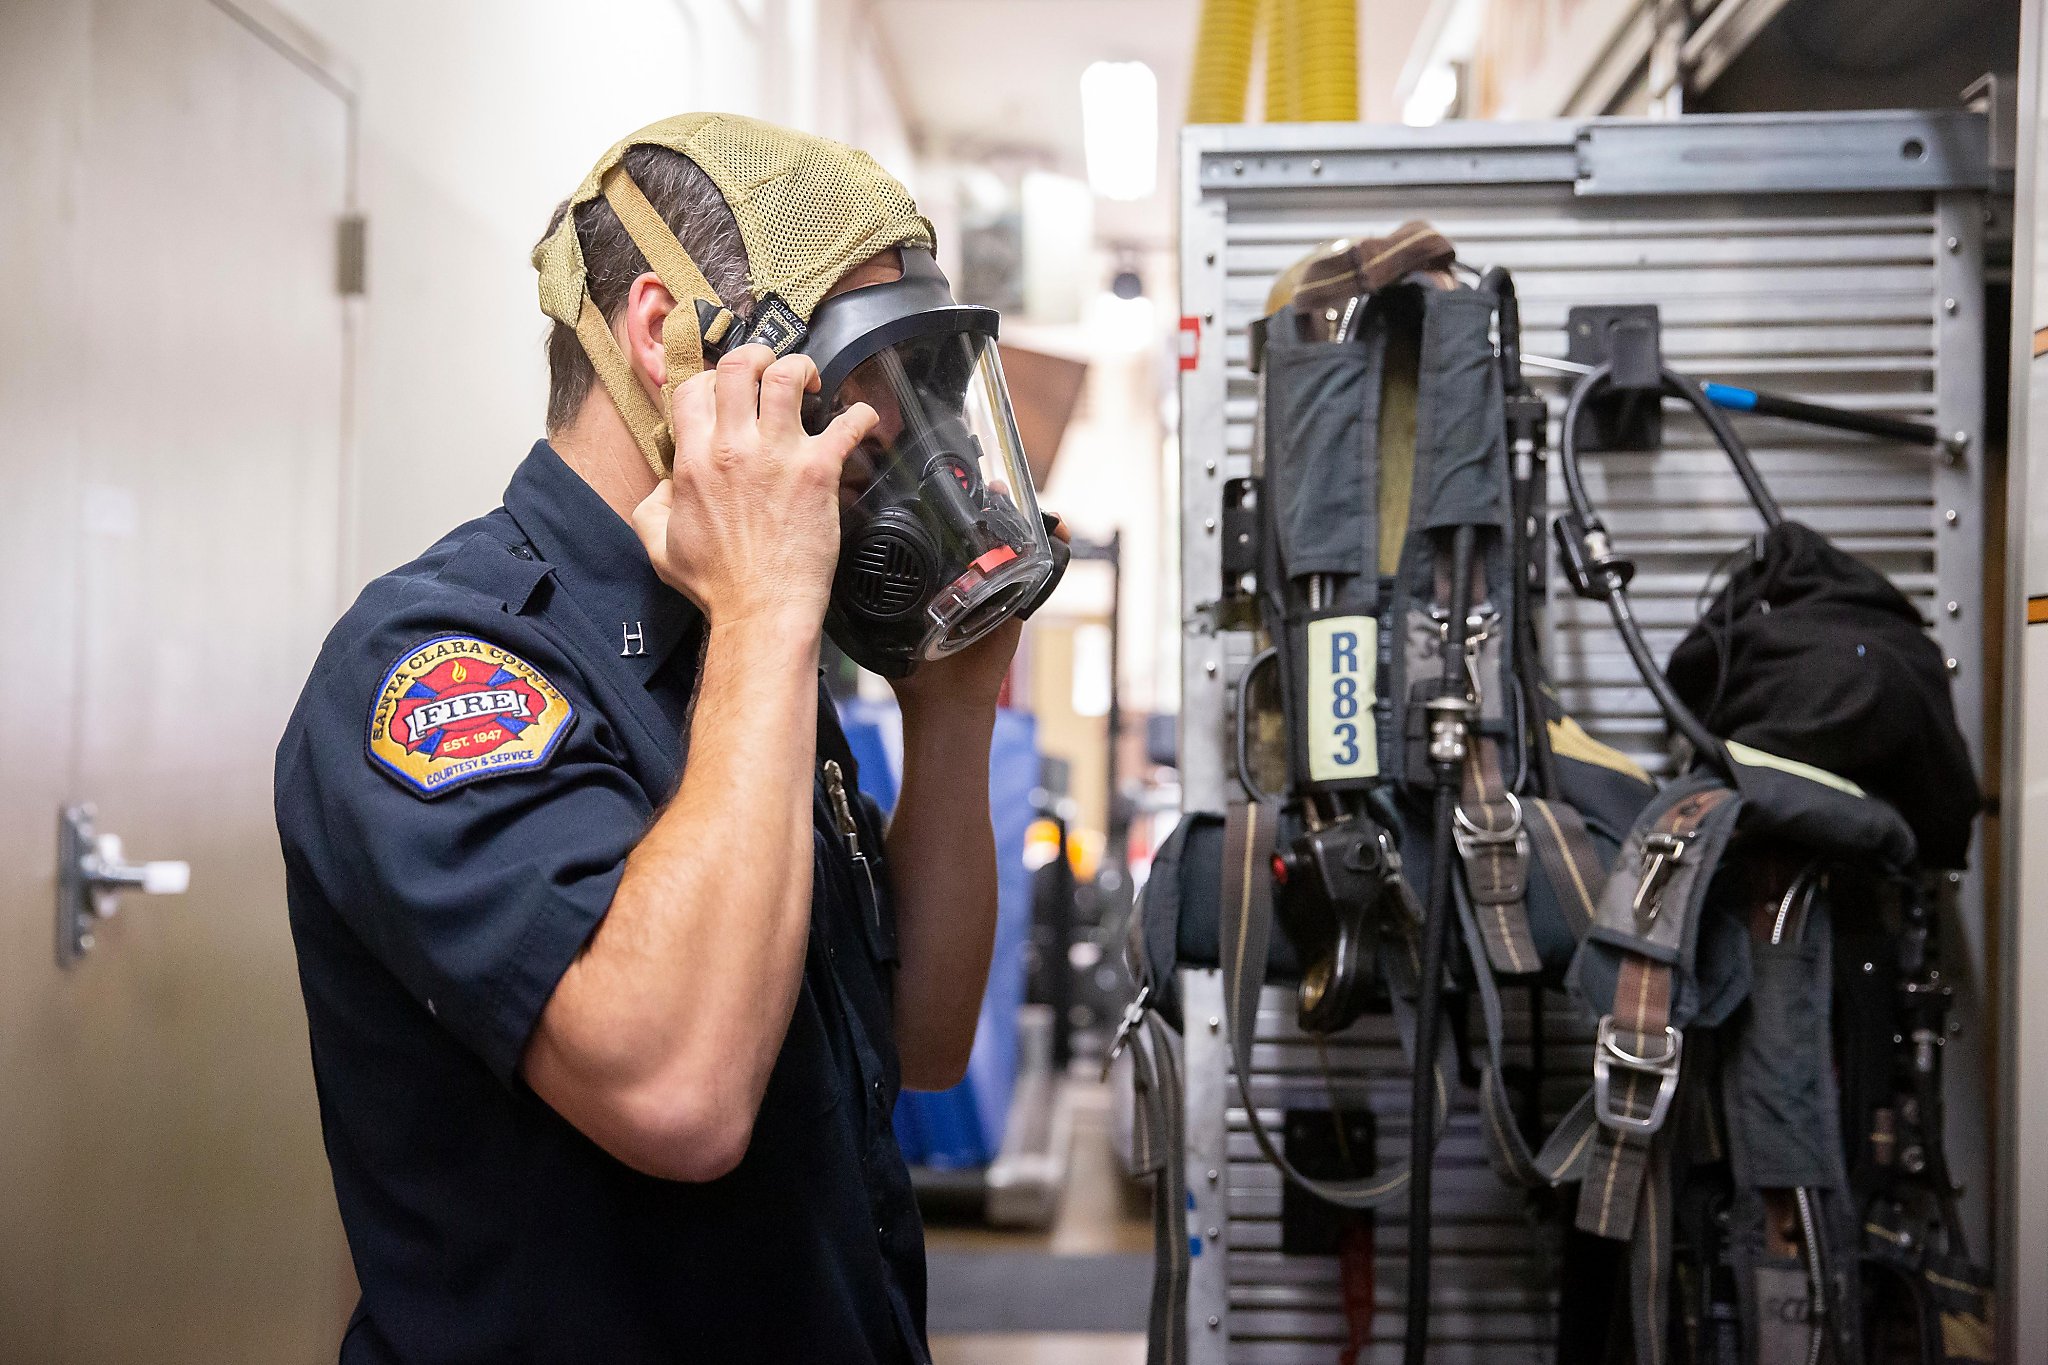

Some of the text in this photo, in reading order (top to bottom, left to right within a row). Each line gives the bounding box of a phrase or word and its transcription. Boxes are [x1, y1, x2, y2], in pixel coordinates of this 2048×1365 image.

[620, 621, 649, 656] H
[372, 641, 566, 741] SANTA CLARA COUNTY
[420, 692, 514, 727] FIRE
[442, 729, 503, 753] EST. 1947
[426, 749, 535, 786] COURTESY & SERVICE
